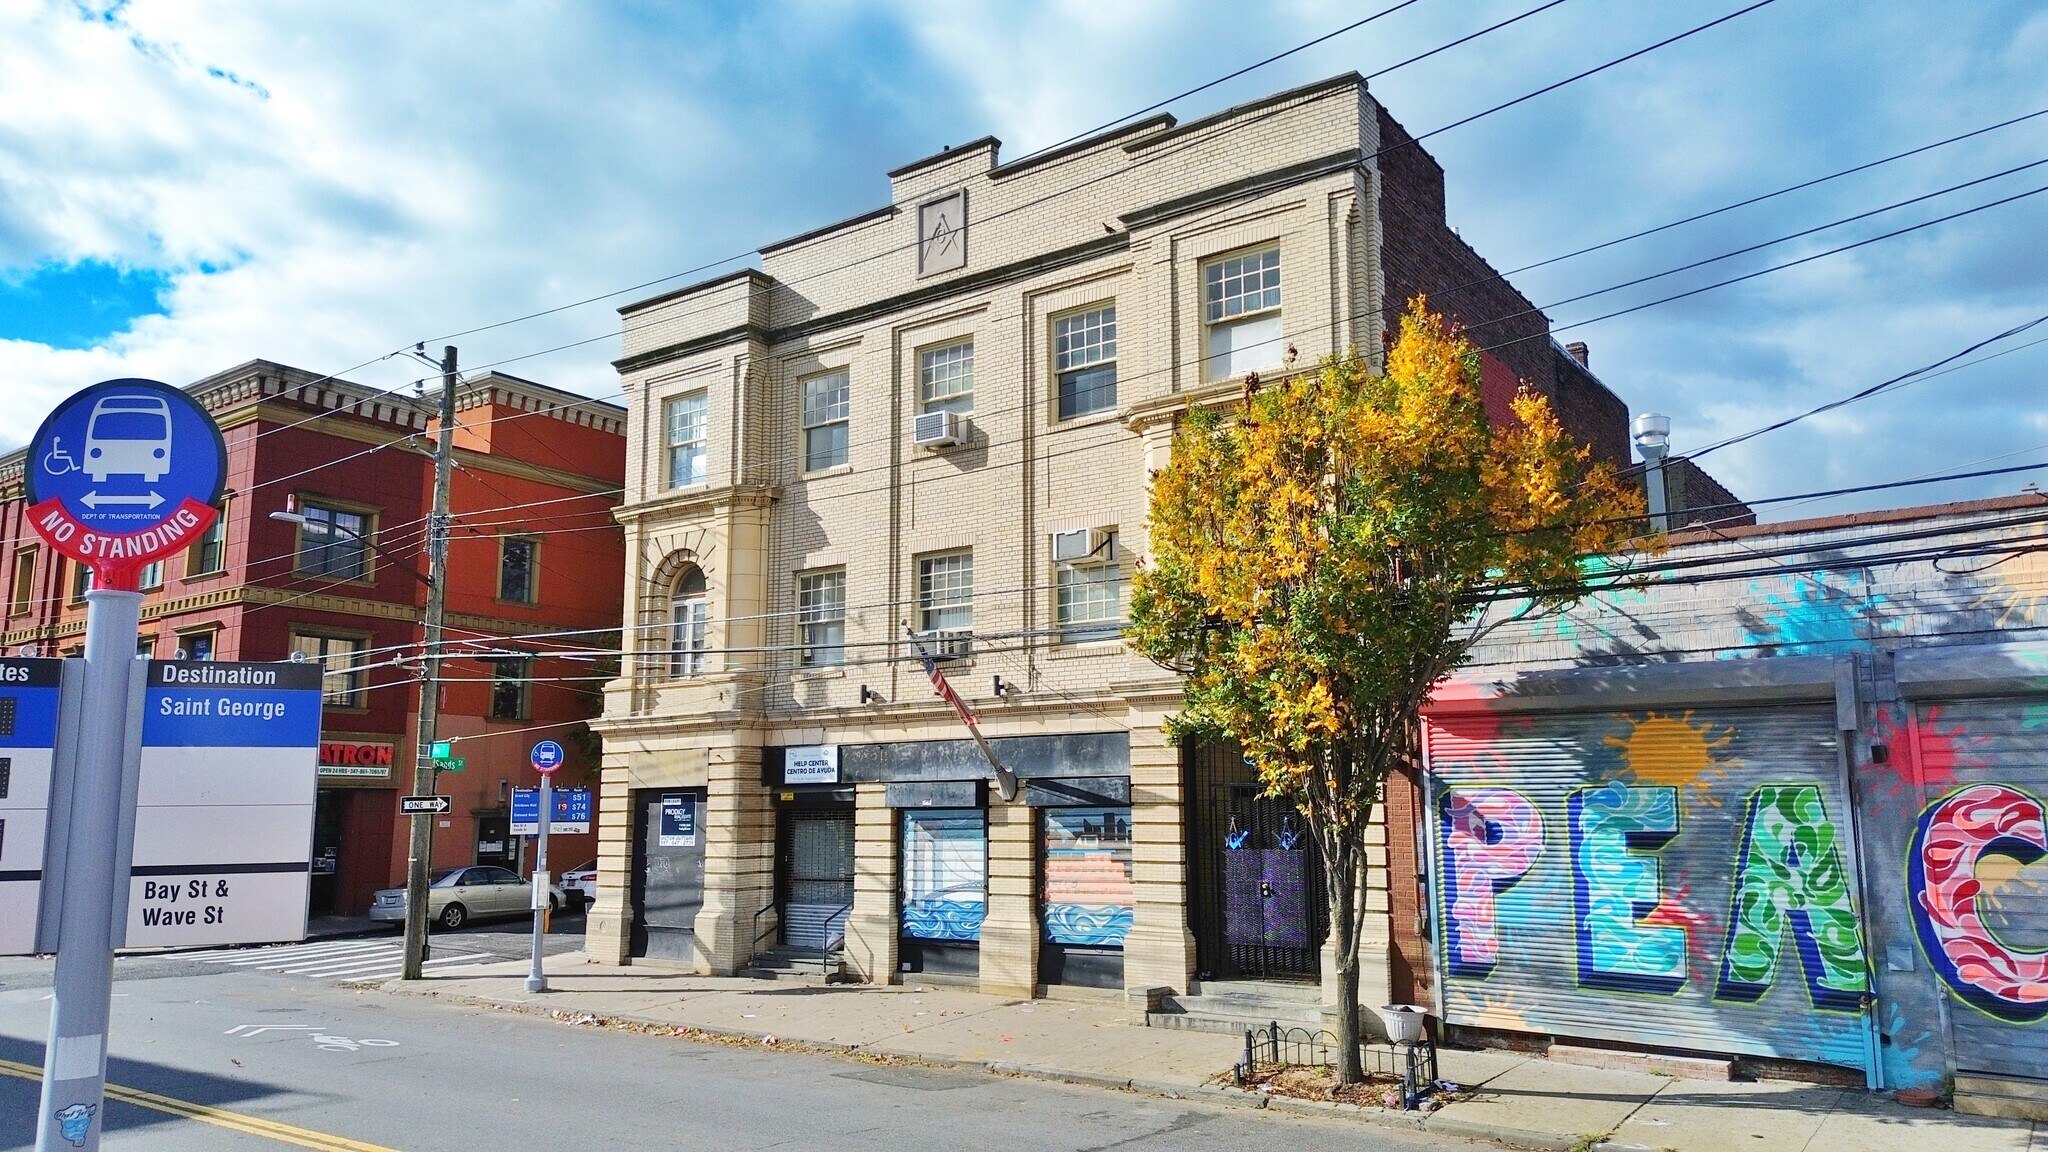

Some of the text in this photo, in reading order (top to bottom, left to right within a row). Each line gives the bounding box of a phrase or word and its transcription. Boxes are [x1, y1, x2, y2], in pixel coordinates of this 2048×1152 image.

[39, 508, 199, 560] NO STANDING
[0, 664, 30, 682] tes
[162, 664, 277, 686] Destination
[160, 697, 286, 721] Saint George
[435, 758, 456, 770] Sands
[408, 801, 444, 809] ONE WAY
[144, 879, 229, 904] Bay St &
[1438, 781, 2048, 1023] PEAC
[142, 905, 224, 927] Wave St
